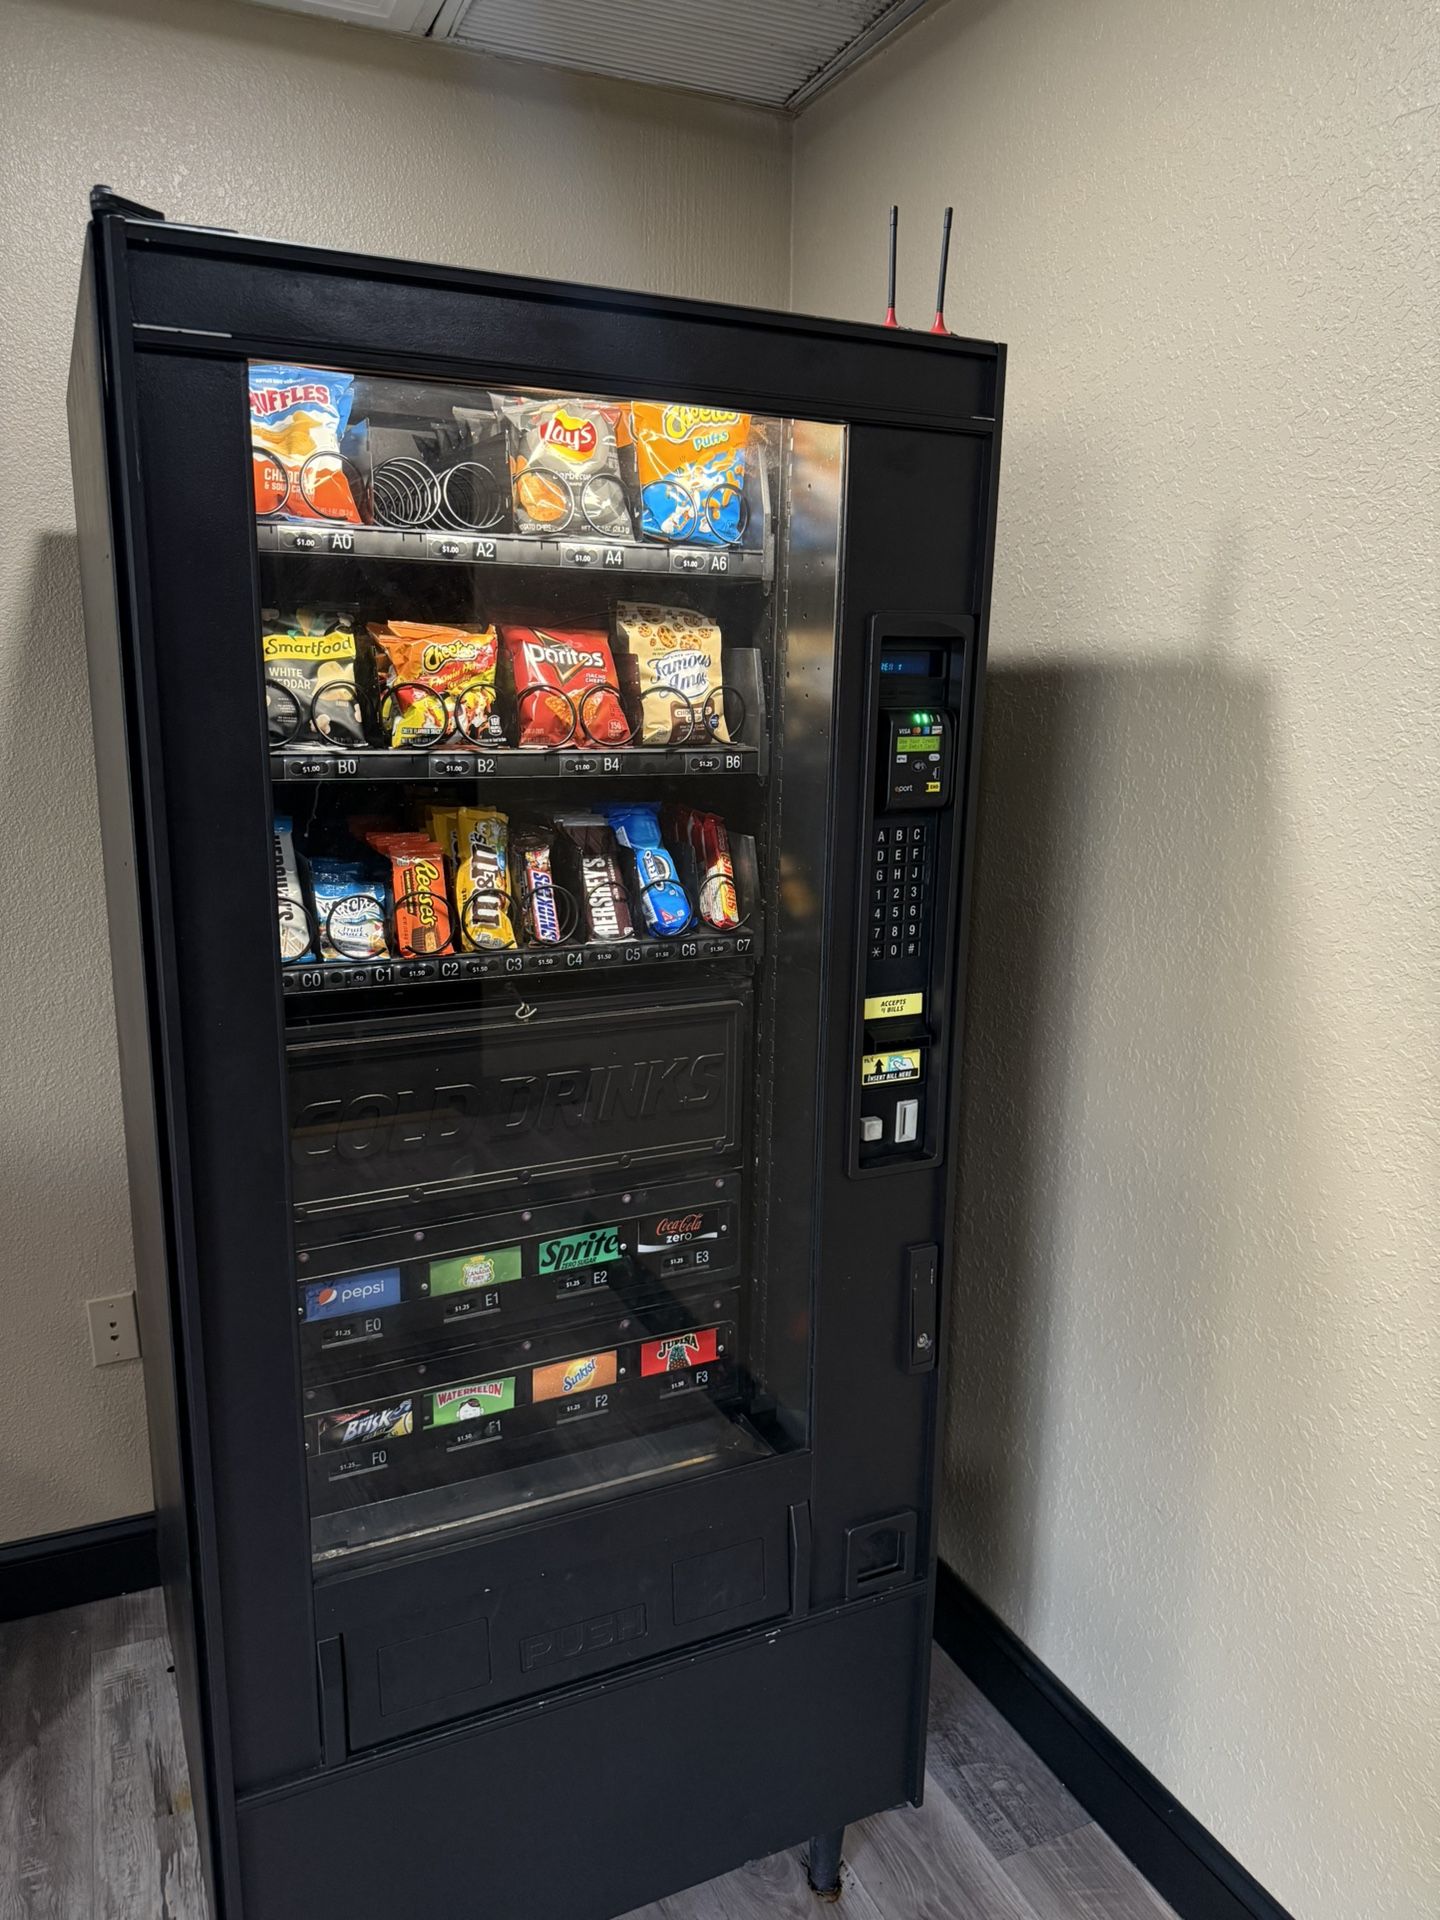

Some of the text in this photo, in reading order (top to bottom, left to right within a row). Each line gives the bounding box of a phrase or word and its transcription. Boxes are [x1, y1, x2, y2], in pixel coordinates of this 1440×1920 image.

[296, 533, 352, 549] $1.00 A0
[441, 543, 494, 558] $1.00 A2
[574, 550, 622, 566] $1.00 A4
[683, 555, 727, 571] $1.00 A6
[265, 636, 353, 656] Smartfood
[424, 641, 476, 672] Cheetos
[523, 643, 604, 668] Doritos
[269, 667, 304, 678] WHITE
[647, 653, 711, 684] Famous
[670, 672, 707, 691] Amos
[899, 727, 911, 735] VISA
[302, 759, 357, 775] $1.00 B0
[446, 758, 495, 773] $1.00 B2
[575, 757, 620, 772] $1.00 B4
[699, 755, 741, 769] $1.25 B6
[878, 828, 921, 842] A B C
[877, 848, 919, 862] D E F
[876, 867, 918, 881] G H J
[413, 858, 441, 931] Reese's
[876, 886, 917, 900] 1 2 3
[533, 872, 559, 941] SNICKERS
[874, 905, 916, 919] 4 5 6
[874, 924, 916, 938] 7 8 9
[681, 943, 697, 957] C6
[710, 938, 751, 954] $1.50 C7
[890, 944, 897, 956] 0
[538, 952, 583, 967] $1.50 C4
[597, 948, 641, 962] $1.50 C5
[409, 961, 460, 977] $1.50 C2
[472, 957, 523, 973] $1.50 C3
[302, 972, 321, 988] C0
[375, 968, 393, 982] C1
[881, 998, 907, 1007] ACCEPTS
[887, 1005, 904, 1013] BILLS
[293, 1052, 726, 1163] COLD DRINKS
[666, 1232, 693, 1244] zero
[540, 1231, 619, 1271] Sprite
[670, 1250, 709, 1265] $1.25 E3
[560, 1256, 597, 1270] ZERO SUGAR
[566, 1271, 608, 1288] $1.25 E2
[341, 1280, 385, 1303] pepsi
[454, 1292, 499, 1312] $1.25 E1
[335, 1317, 382, 1337] $1.25 E0
[563, 1358, 597, 1392] Sunkist
[696, 1370, 709, 1384] F3
[437, 1382, 503, 1406] WATERMELON
[595, 1394, 608, 1408] F2
[488, 1420, 501, 1434] F1
[339, 1450, 387, 1471] $1.25 F0
